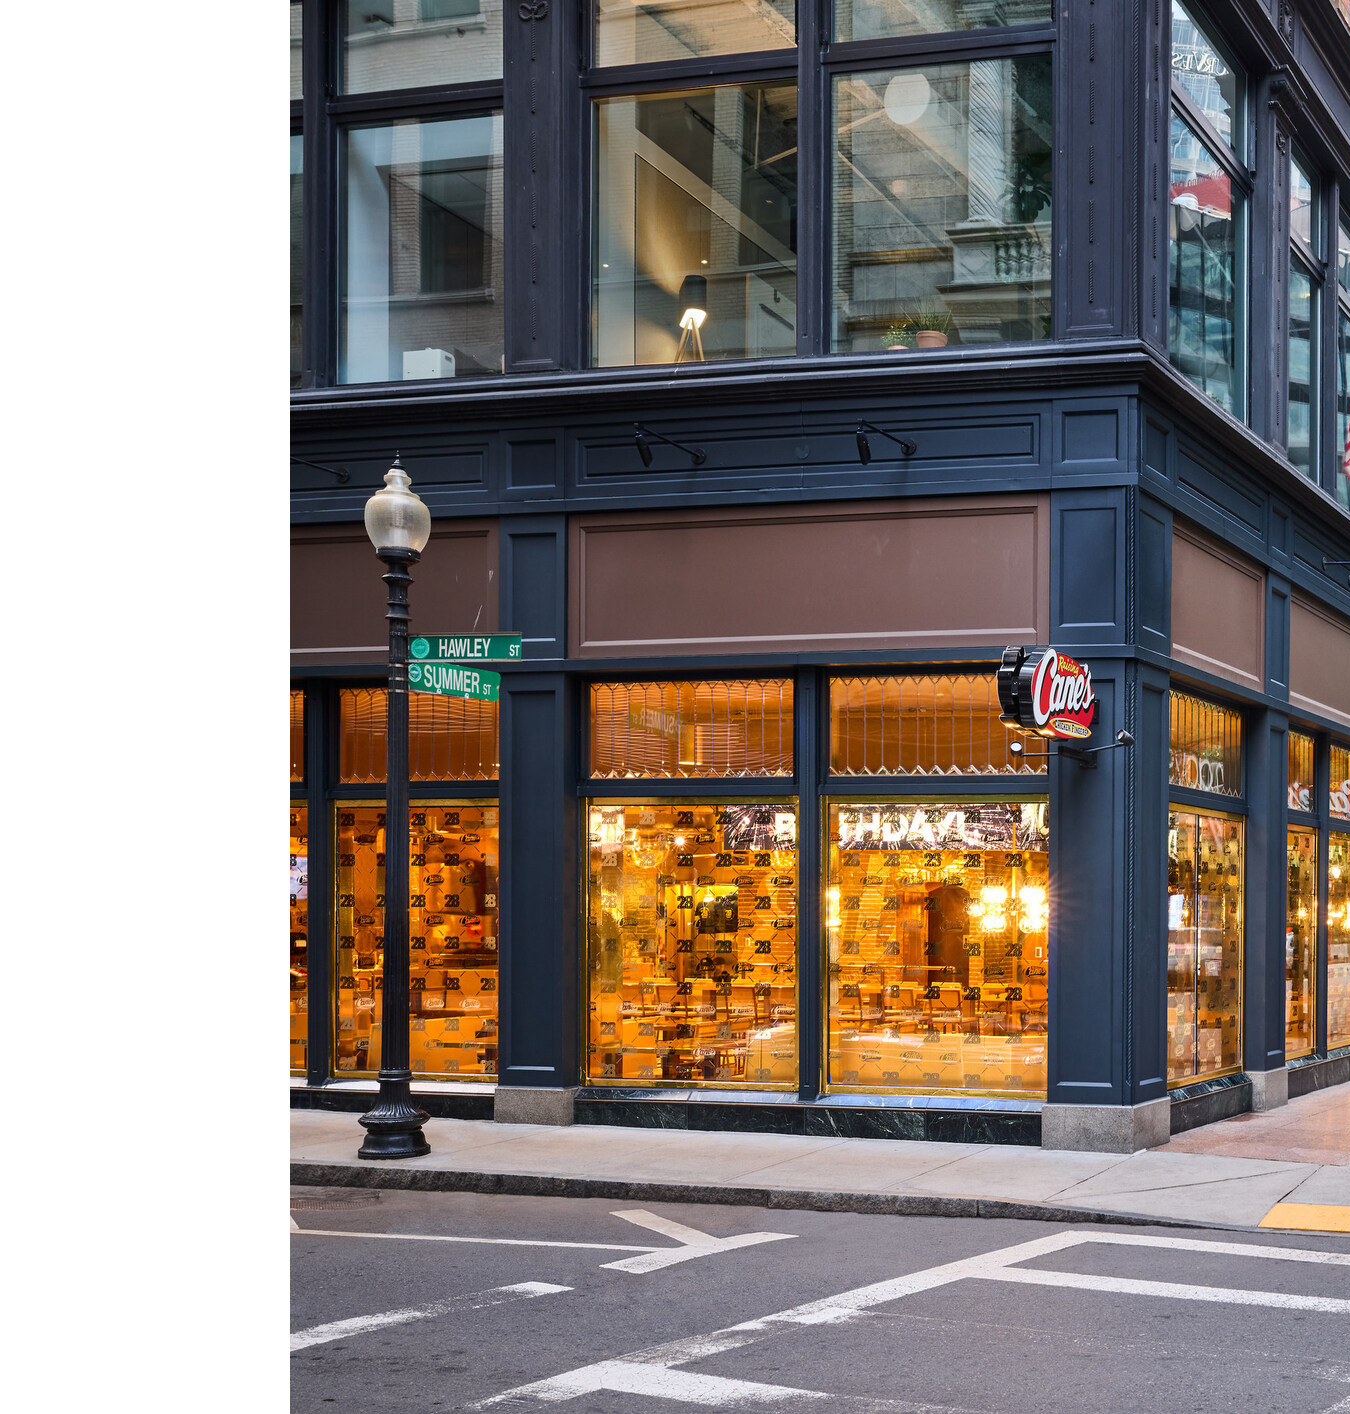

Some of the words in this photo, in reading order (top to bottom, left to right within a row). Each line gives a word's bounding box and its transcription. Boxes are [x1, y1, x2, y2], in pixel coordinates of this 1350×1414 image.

[438, 638, 491, 658] HAWLEY
[509, 644, 520, 657] ST
[1058, 656, 1079, 678] Raising
[423, 664, 480, 694] SUMMER
[482, 683, 492, 696] ST
[1033, 648, 1095, 726] Cane's
[411, 813, 426, 826] 28
[444, 813, 459, 826] 28
[677, 812, 693, 824] 28
[964, 809, 981, 823] 28
[411, 854, 426, 866] 28
[444, 854, 459, 866] 28
[677, 853, 693, 867] 28
[715, 853, 732, 867] 28
[755, 853, 771, 867] 28
[964, 853, 981, 867] 28
[1005, 853, 1022, 867] 28
[340, 894, 355, 907] 28
[376, 894, 385, 907] 2
[411, 894, 426, 907] 28
[444, 894, 459, 907] 28
[677, 896, 693, 909] 28
[755, 896, 771, 909] 28
[411, 936, 426, 949] 28
[444, 936, 459, 949] 28
[676, 940, 692, 953] 28
[715, 941, 732, 953] 28
[755, 941, 771, 954] 28
[1005, 943, 1022, 957] 28
[411, 977, 426, 990] 28
[444, 977, 459, 990] 28
[481, 977, 496, 990] 28
[676, 982, 692, 995] 28
[923, 986, 940, 999] 28
[964, 987, 981, 1000] 28
[1005, 987, 1022, 1001] 28
